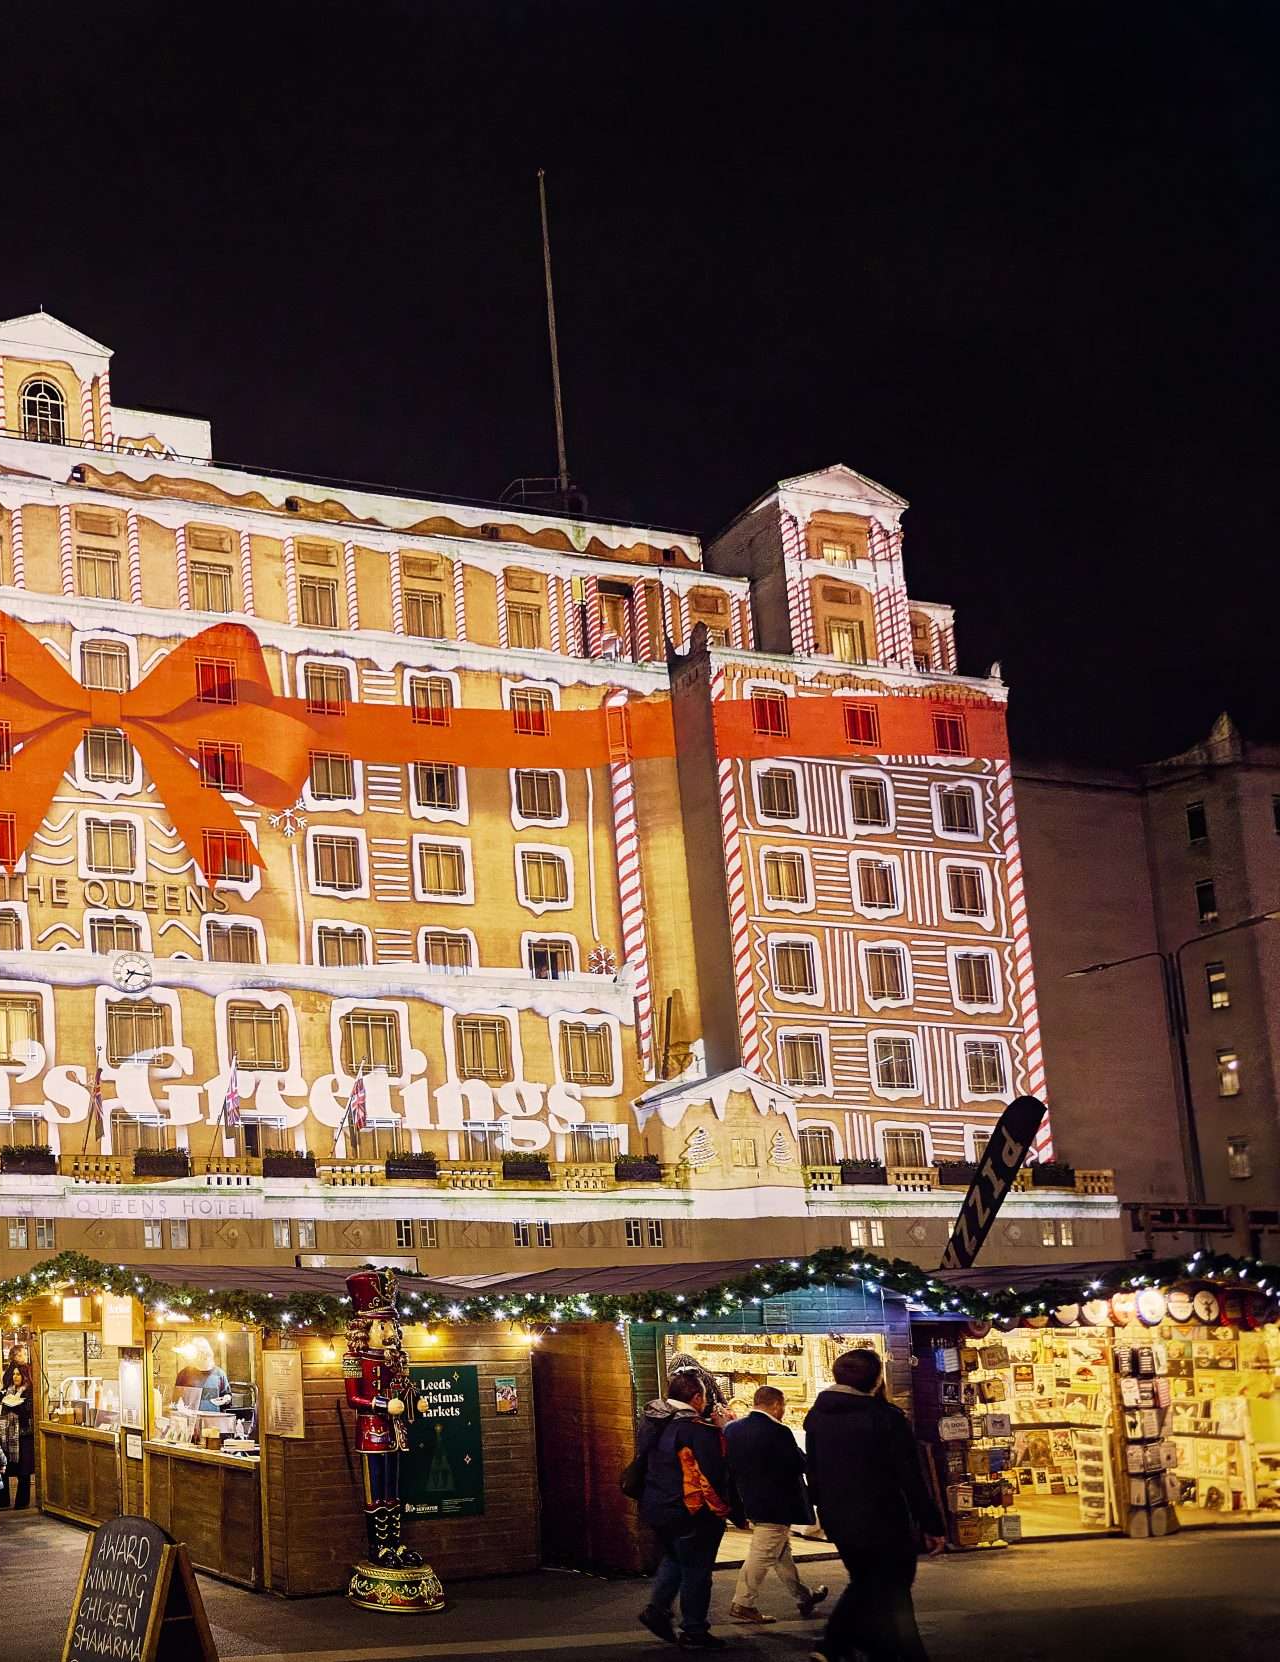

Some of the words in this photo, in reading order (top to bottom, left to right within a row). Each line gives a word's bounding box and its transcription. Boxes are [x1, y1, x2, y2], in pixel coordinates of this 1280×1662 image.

[84, 879, 231, 914] QUEENS
[113, 1045, 587, 1153] Greetings
[77, 1199, 167, 1216] QUEENS
[183, 1200, 254, 1217] HOTEL
[419, 1392, 464, 1404] ristmas
[420, 1379, 452, 1391] Leeds
[422, 1406, 461, 1418] arkets
[97, 1534, 150, 1569] AWARD
[85, 1567, 148, 1609] WINNING
[79, 1597, 138, 1633] CHICKEN
[73, 1624, 142, 1662] SHAWARMA
